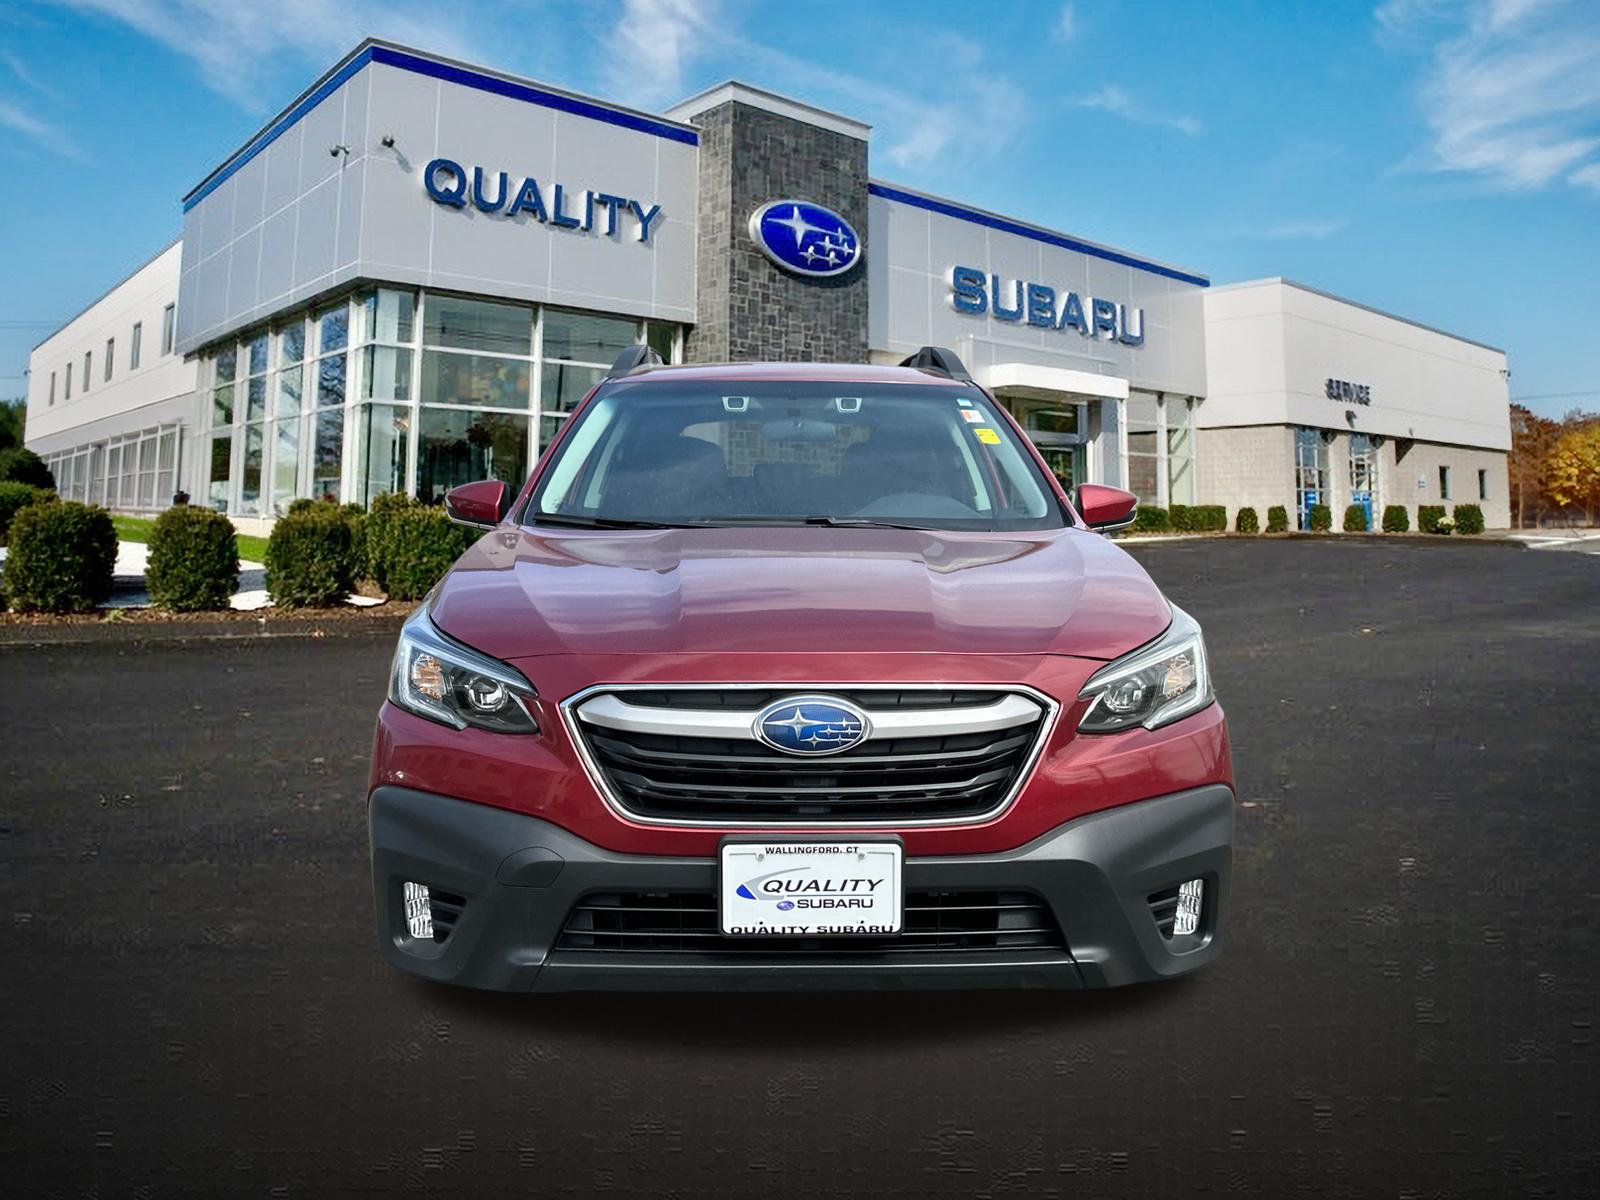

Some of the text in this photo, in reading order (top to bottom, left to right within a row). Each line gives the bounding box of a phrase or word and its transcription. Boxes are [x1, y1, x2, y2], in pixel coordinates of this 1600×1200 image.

[424, 158, 661, 242] QUALITY
[950, 265, 1145, 346] SUBARU
[1325, 378, 1371, 406] SERVICE
[846, 846, 859, 854] CT
[763, 879, 884, 893] QUALITY
[797, 899, 873, 908] SUBARU
[730, 925, 894, 934] QUALITY SUBARU
